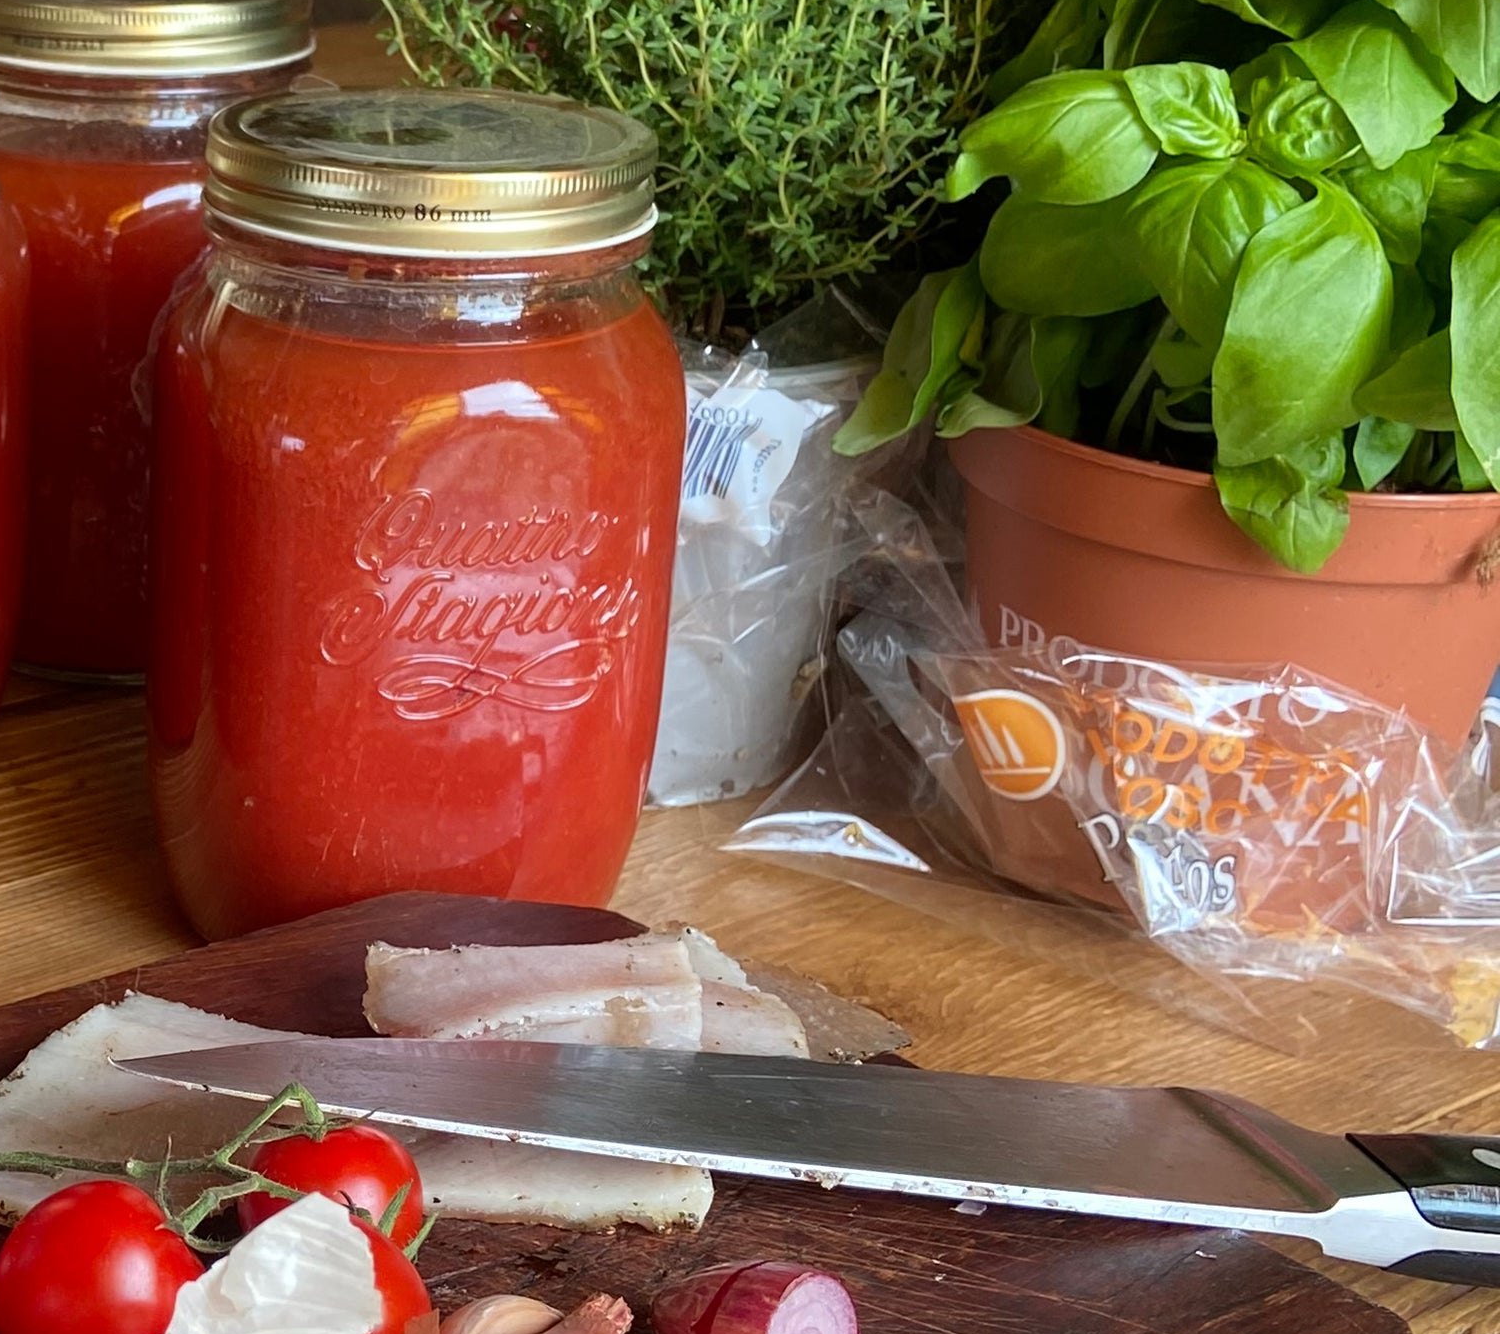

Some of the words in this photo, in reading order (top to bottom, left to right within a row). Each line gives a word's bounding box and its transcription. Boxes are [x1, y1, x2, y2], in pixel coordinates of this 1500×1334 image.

[315, 199, 405, 220] DIAMETRO
[414, 203, 441, 222] 86
[451, 209, 491, 223] mm
[354, 488, 608, 582] Quattro
